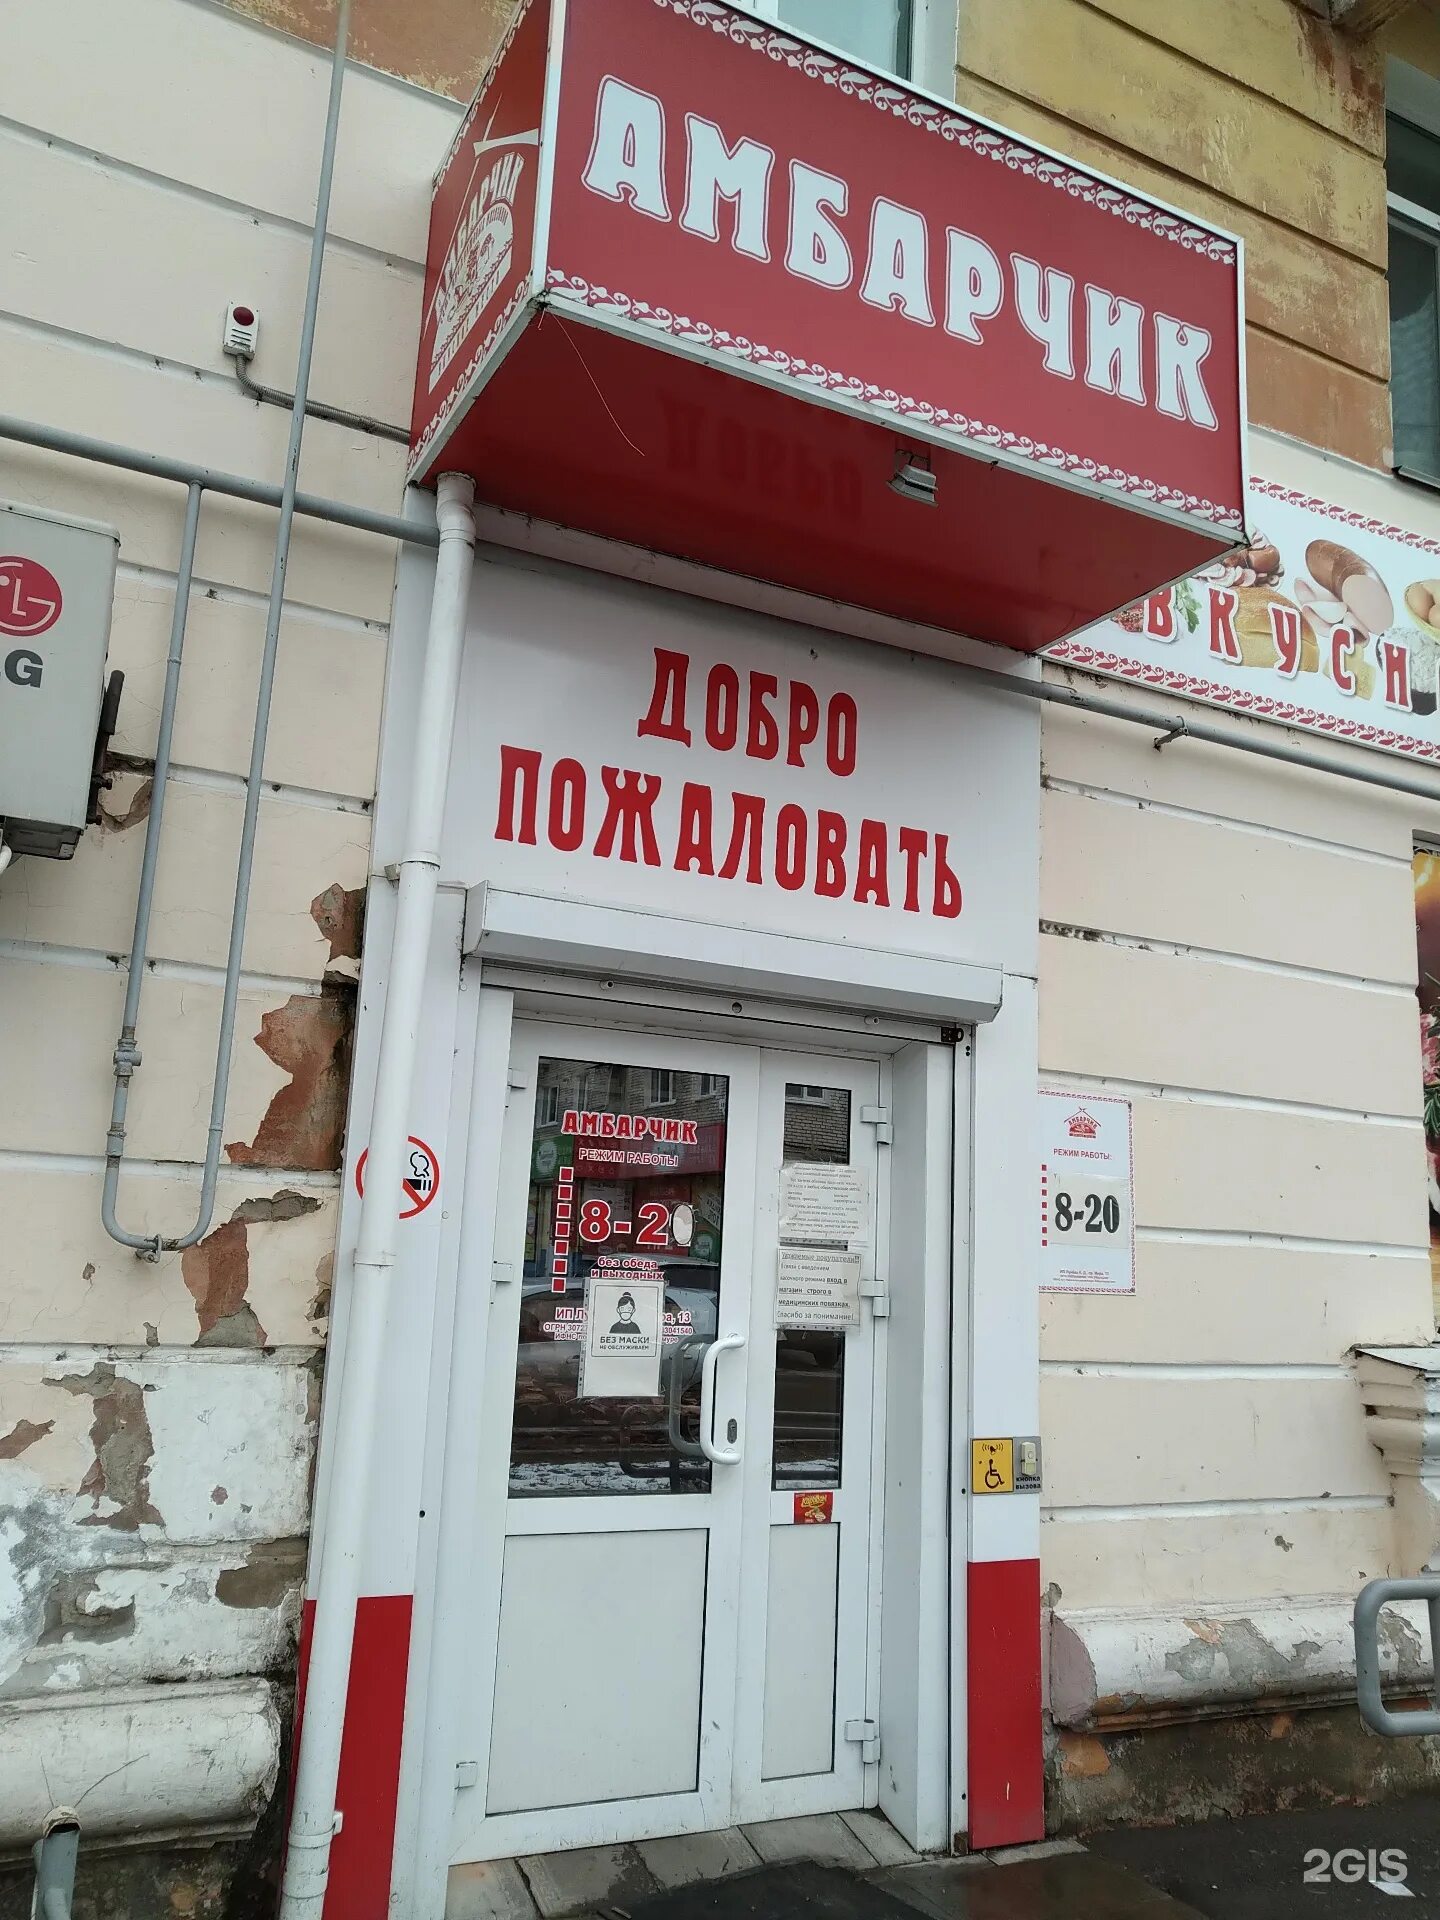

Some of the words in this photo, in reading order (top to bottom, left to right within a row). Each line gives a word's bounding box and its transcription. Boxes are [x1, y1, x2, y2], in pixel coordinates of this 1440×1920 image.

[580, 73, 1219, 431] АМБАРЧИК
[637, 647, 858, 777] ДОБРО
[494, 744, 963, 919] ПОЖАЛОВАТЬ
[561, 1110, 697, 1144] АМБАРЧИК
[579, 1148, 625, 1163] РЕЖИМ
[627, 1152, 679, 1166] РАБОТЫ
[1053, 1148, 1079, 1157] РЕЖИМ
[1055, 1192, 1120, 1233] 8-20
[597, 1256, 621, 1268] без
[623, 1257, 659, 1269] обеда
[591, 1269, 599, 1279] и
[602, 1269, 665, 1280] выходных
[555, 1307, 574, 1320] ИП
[678, 1311, 691, 1323] 13
[544, 1322, 566, 1332] ОГРН
[555, 1332, 577, 1340] ИФНС
